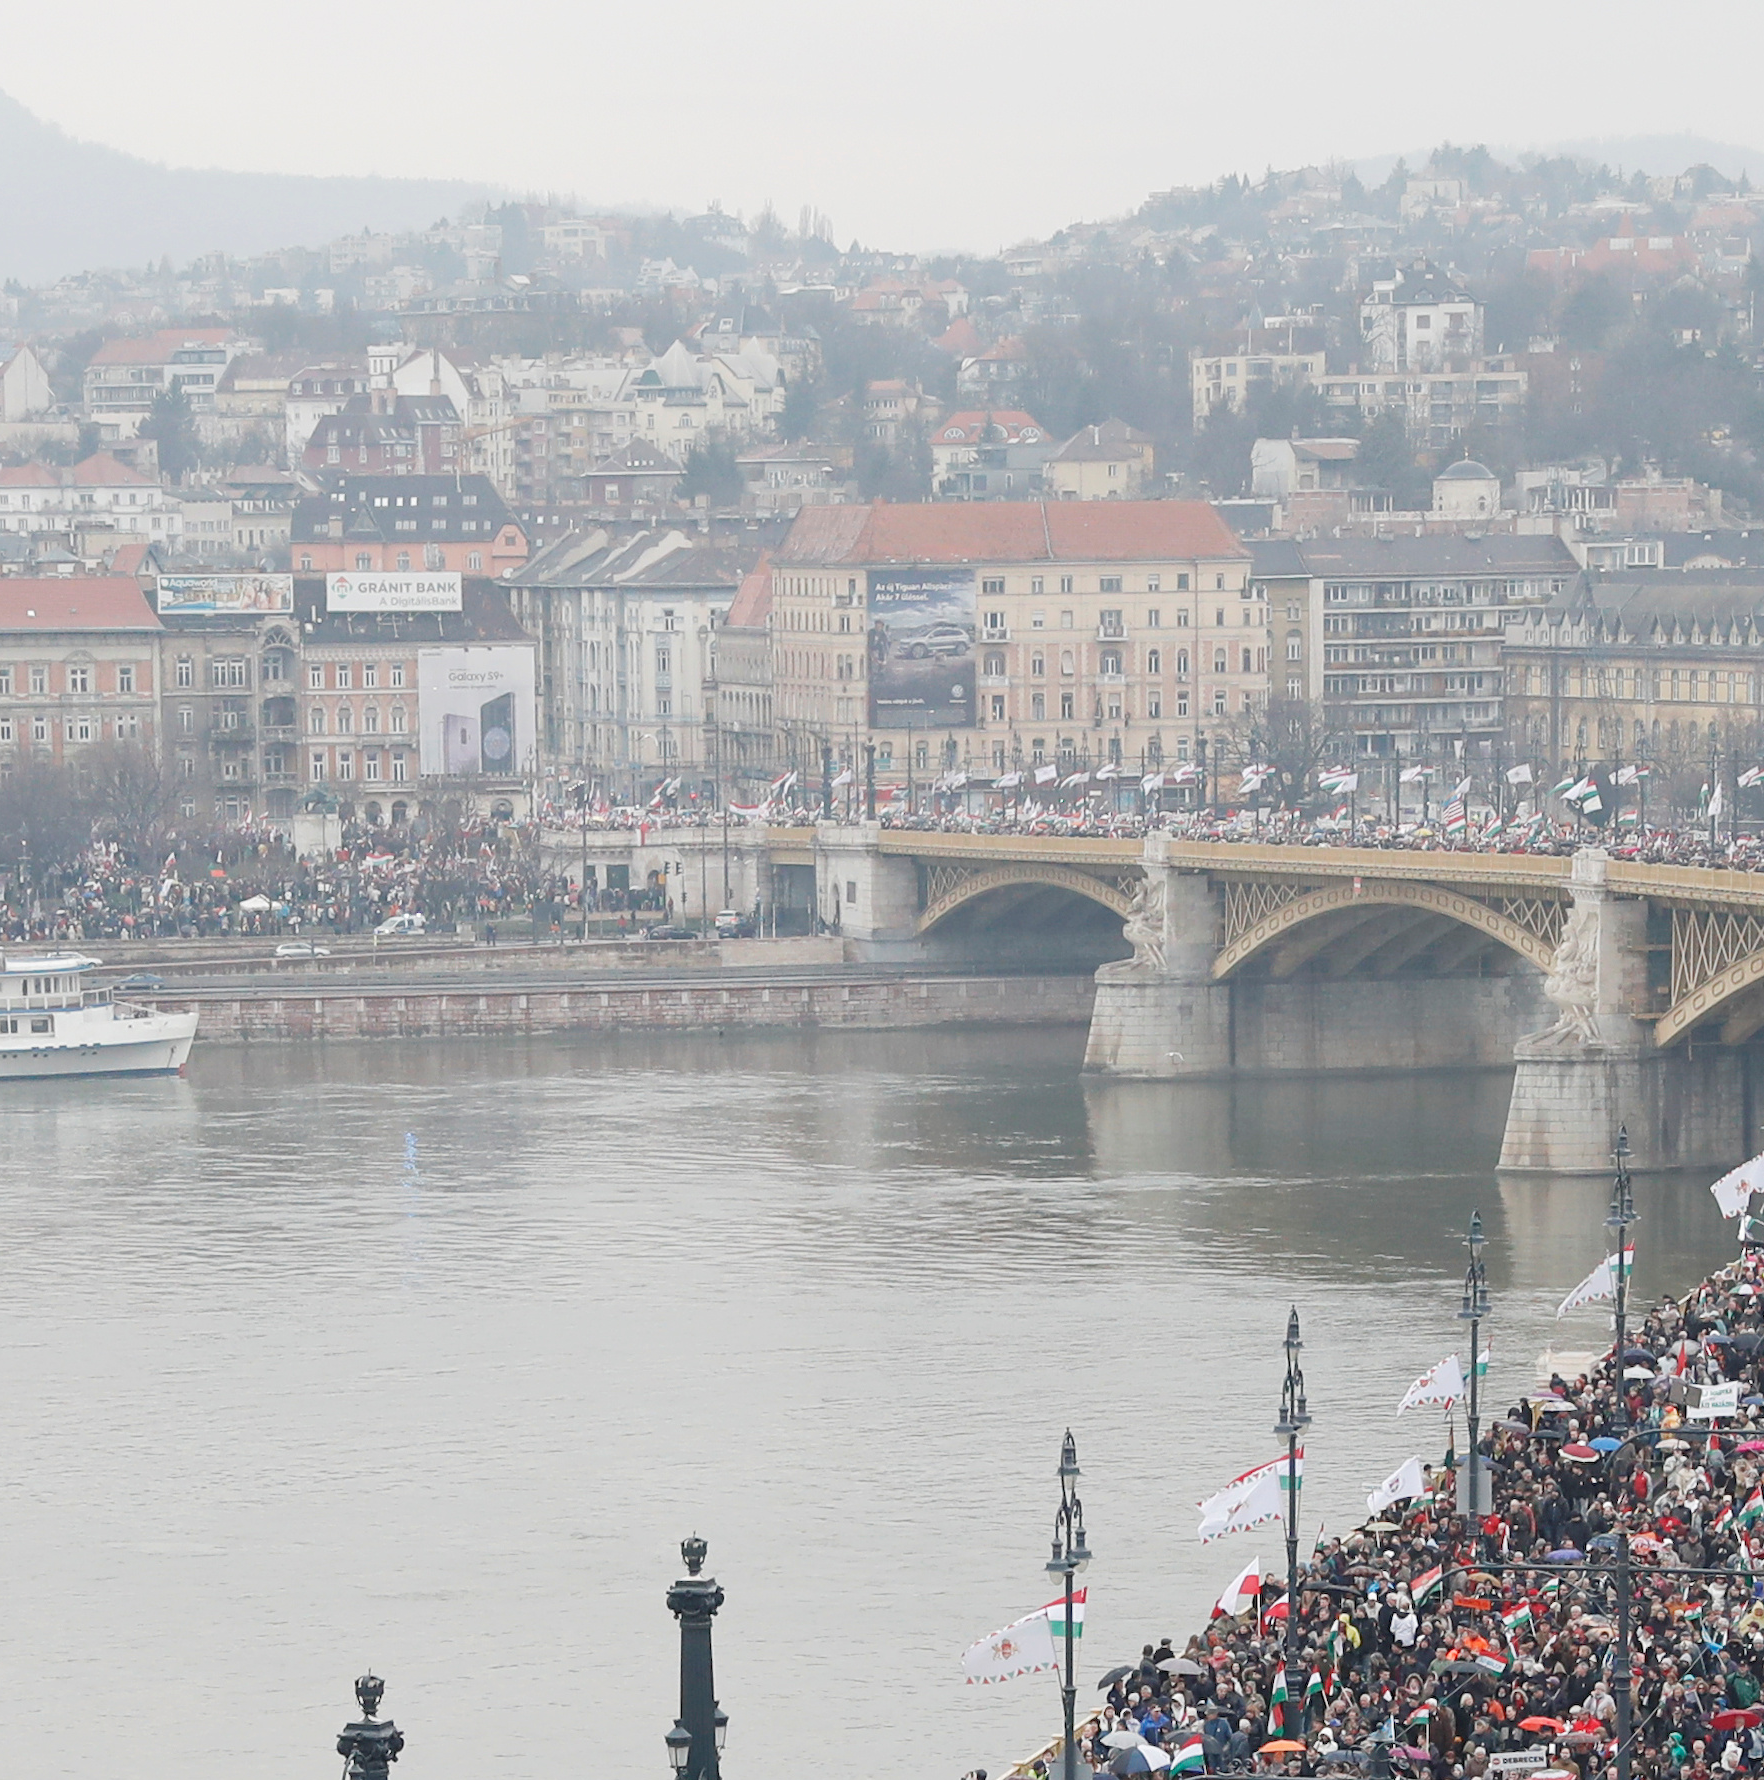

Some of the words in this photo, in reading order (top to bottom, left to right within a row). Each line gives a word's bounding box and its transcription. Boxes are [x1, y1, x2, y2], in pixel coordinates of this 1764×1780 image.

[358, 580, 413, 594] GRÁNIT
[416, 582, 457, 594] BANK
[379, 597, 387, 606] A
[448, 672, 486, 683] Galaxy
[1503, 1756, 1544, 1765] DEBRECEN
